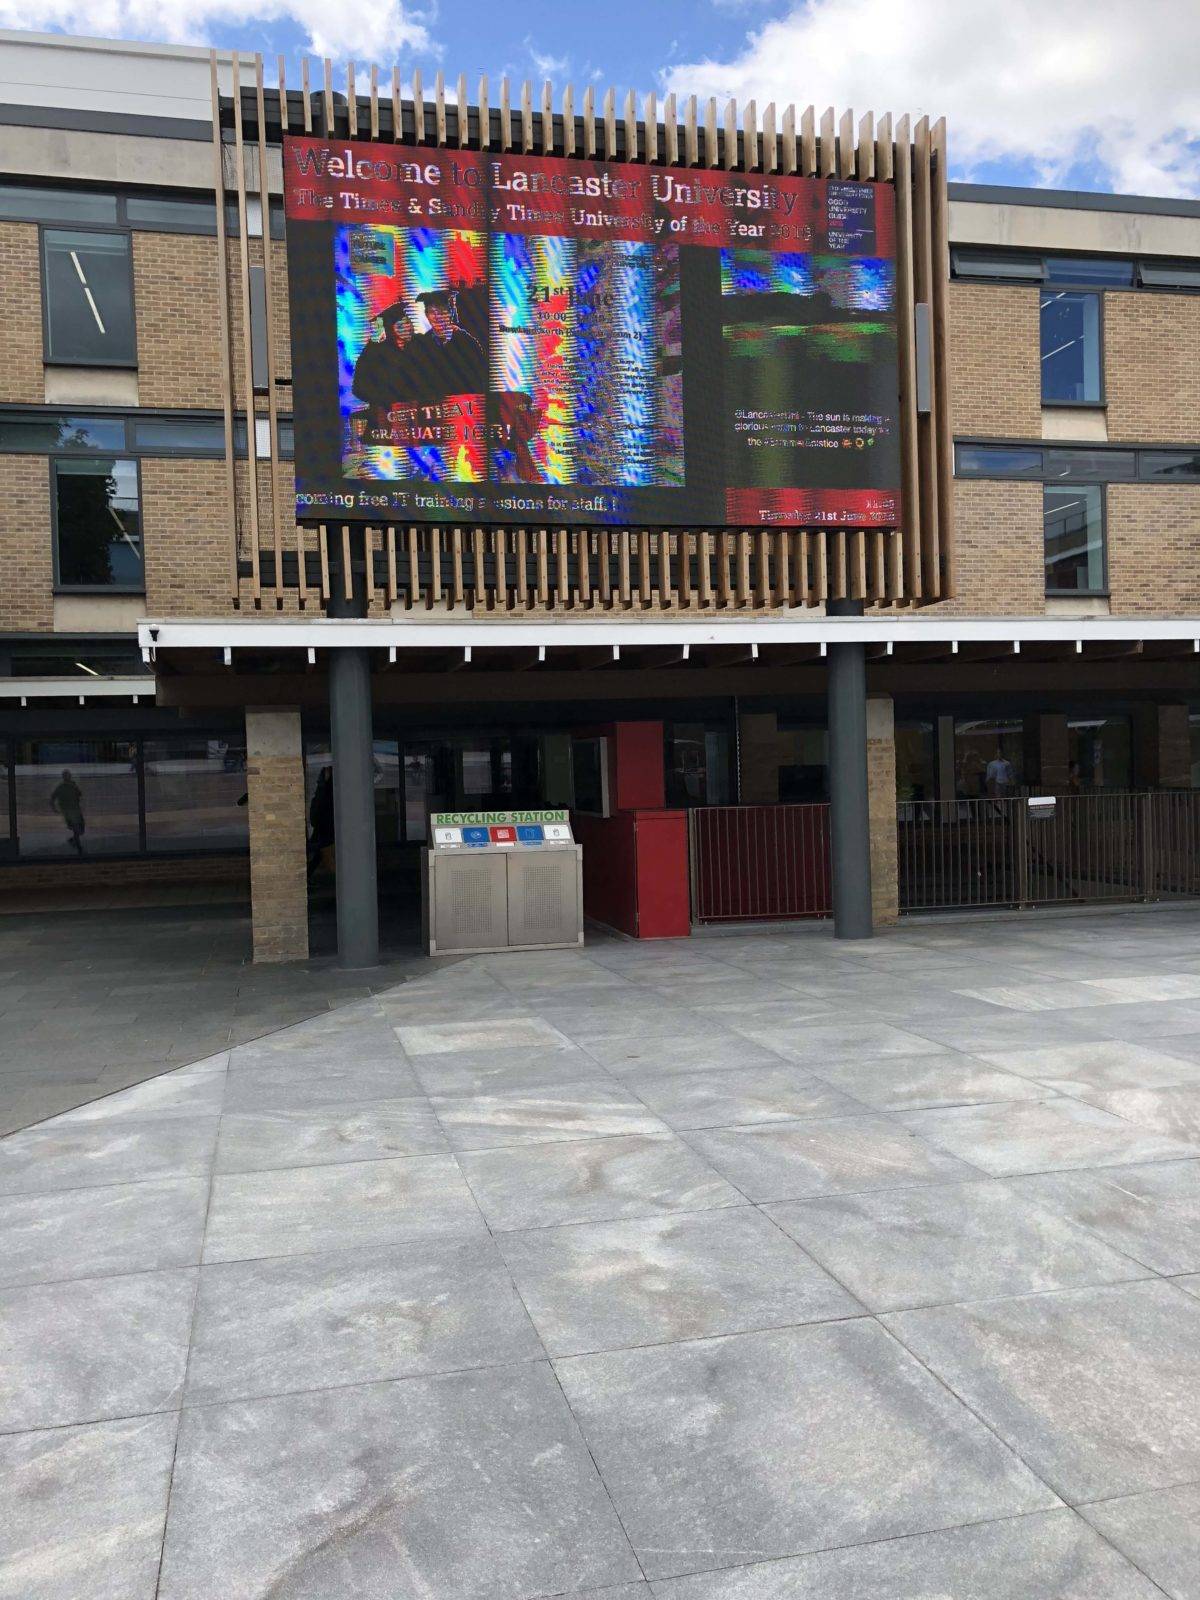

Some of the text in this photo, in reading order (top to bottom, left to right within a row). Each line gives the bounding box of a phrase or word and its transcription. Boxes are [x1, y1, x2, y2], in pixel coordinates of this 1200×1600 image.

[291, 146, 798, 216] Welcome to Lancaster University
[294, 188, 334, 208] The
[408, 198, 423, 214] &
[670, 216, 688, 232] of
[725, 219, 766, 238] Year
[826, 412, 841, 421] sun
[436, 810, 565, 825] RECYCLING STATION
